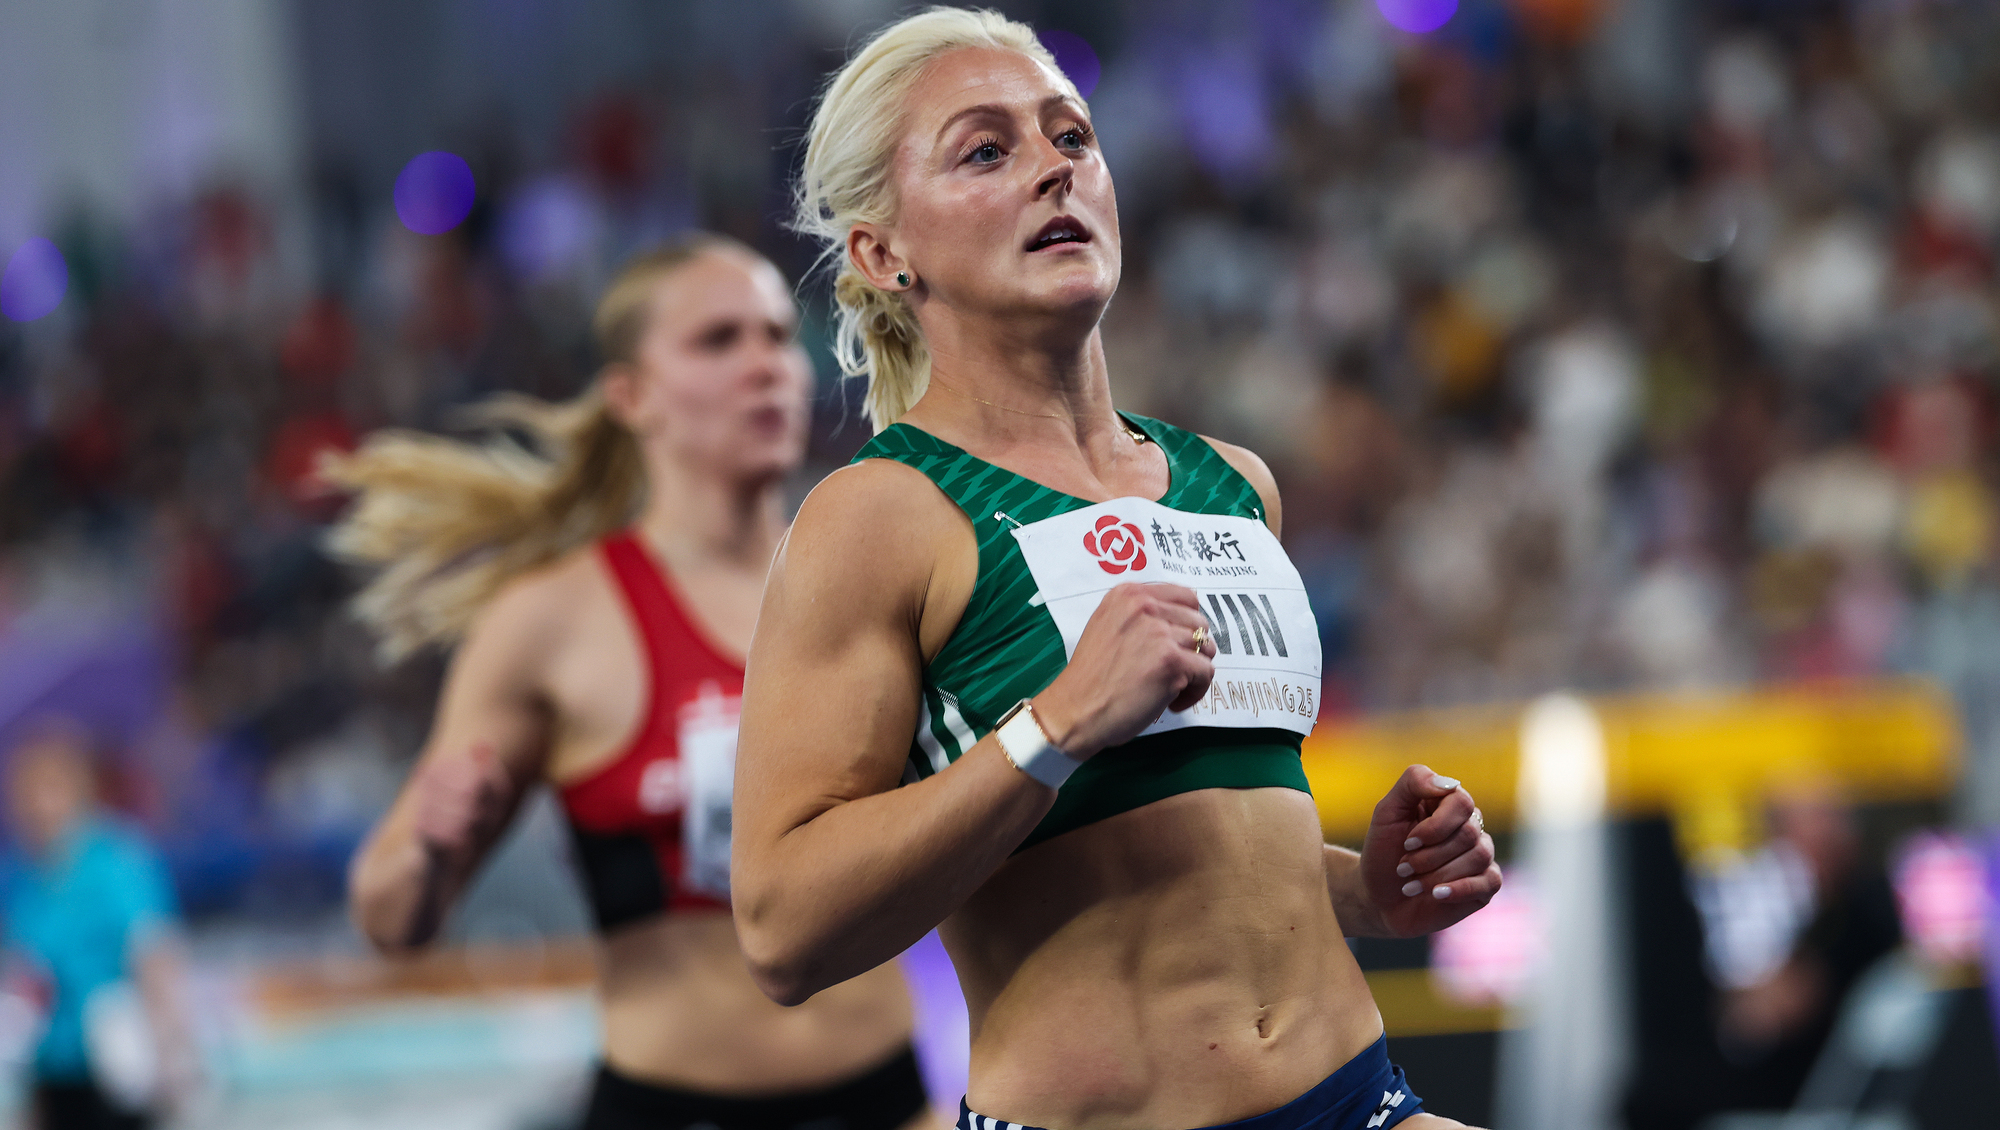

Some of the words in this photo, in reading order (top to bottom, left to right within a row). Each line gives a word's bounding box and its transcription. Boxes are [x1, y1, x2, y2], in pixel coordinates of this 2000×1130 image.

[1161, 559, 1187, 575] BANK
[1188, 565, 1202, 576] OF
[1205, 565, 1258, 577] NANJING
